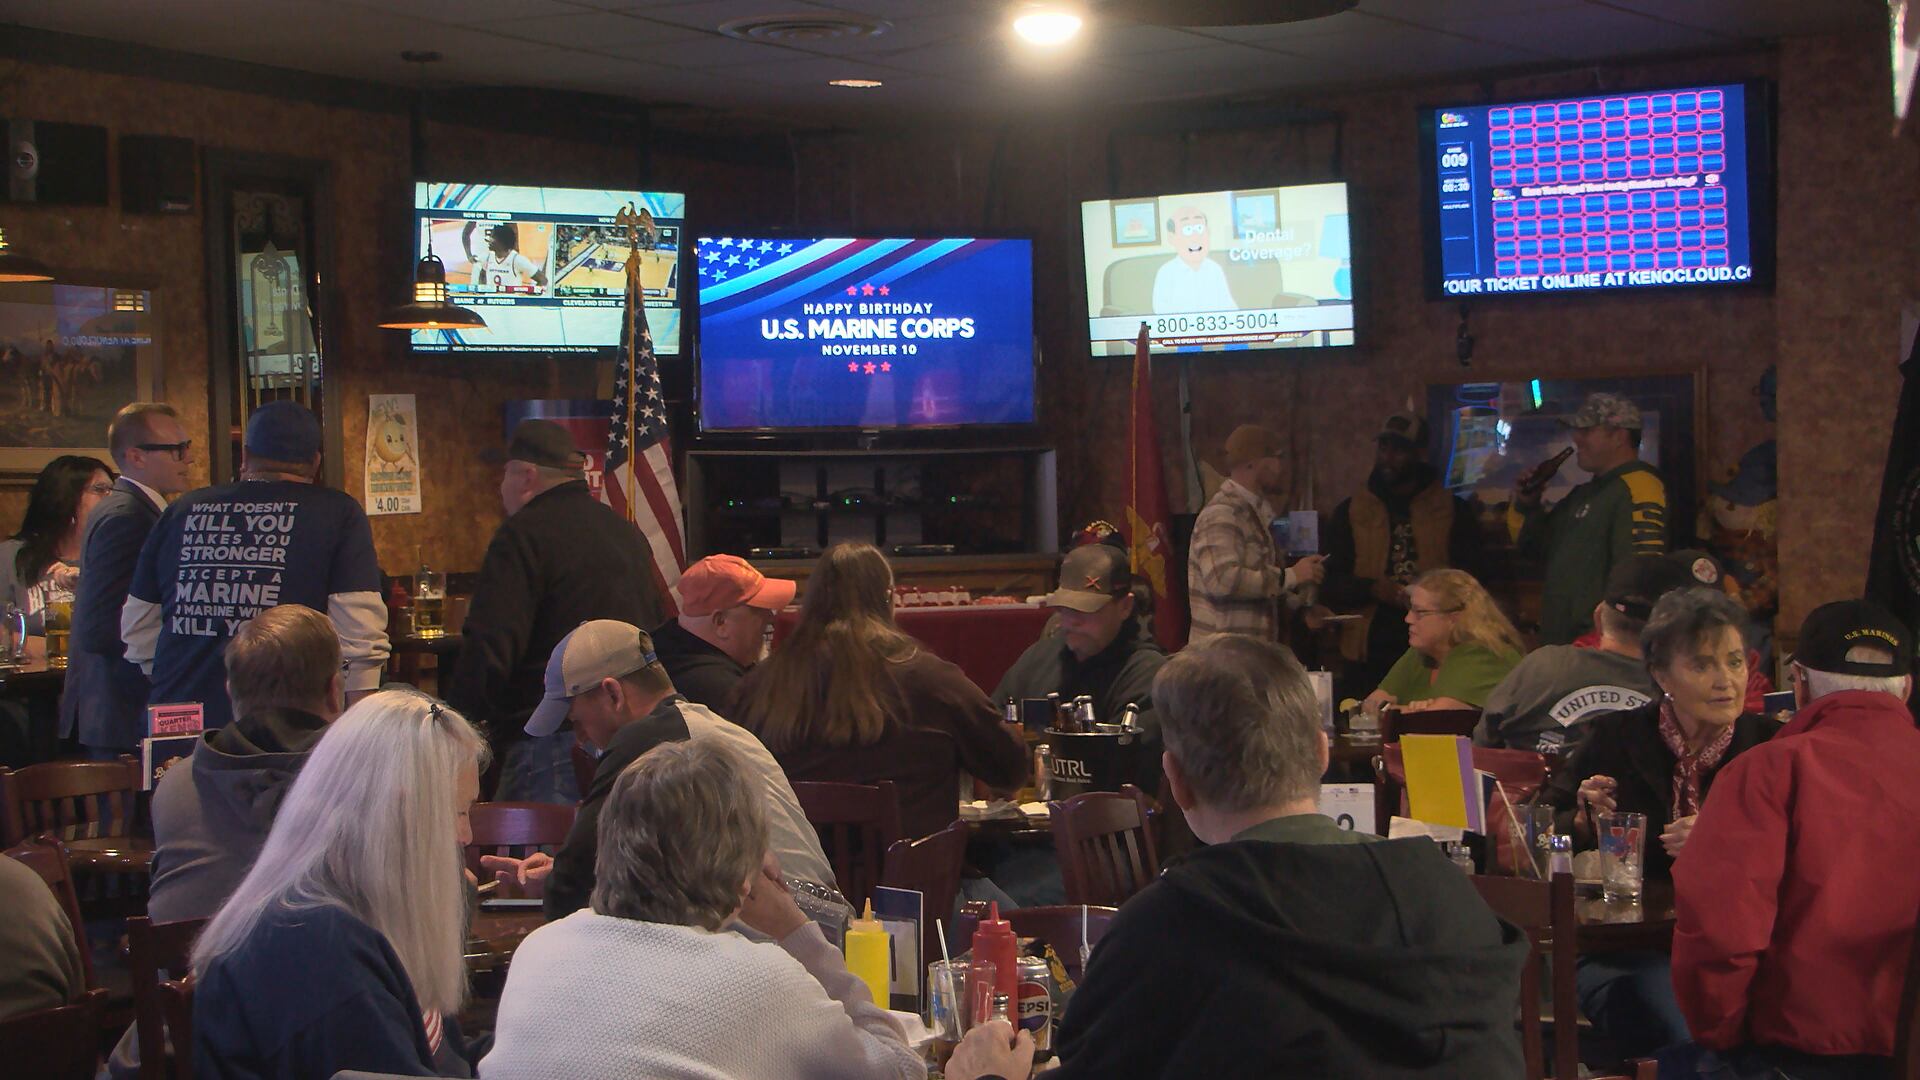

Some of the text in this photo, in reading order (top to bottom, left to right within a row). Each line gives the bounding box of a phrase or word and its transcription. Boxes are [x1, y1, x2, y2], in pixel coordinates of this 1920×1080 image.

[1442, 153, 1468, 168] 009
[1245, 228, 1294, 243] Dental
[1229, 243, 1312, 262] Coverage?
[1444, 276, 1482, 294] OUR
[1484, 275, 1538, 292] TICKET
[1542, 272, 1600, 290] ONLINE
[1604, 270, 1626, 286] AT
[804, 303, 933, 315] HAPPY BIRTHDAY
[761, 318, 975, 340] U.S. MARINE CORPS
[822, 344, 917, 356] NOVEMBER 10
[192, 502, 298, 513] WHAT DOESN'T
[184, 515, 294, 533] KILL YOU
[182, 534, 291, 547] MAKES YOU
[180, 546, 286, 563] STRONGER
[178, 569, 282, 584] EXCEPT A
[175, 582, 280, 606] MARINE
[184, 605, 235, 617] MARINE
[172, 616, 218, 636] KILL
[1844, 629, 1900, 647] U.S. MARINES
[1558, 690, 1620, 719] UNITED
[159, 716, 192, 727] QUARTER
[1018, 1001, 1049, 1013] EPSI
